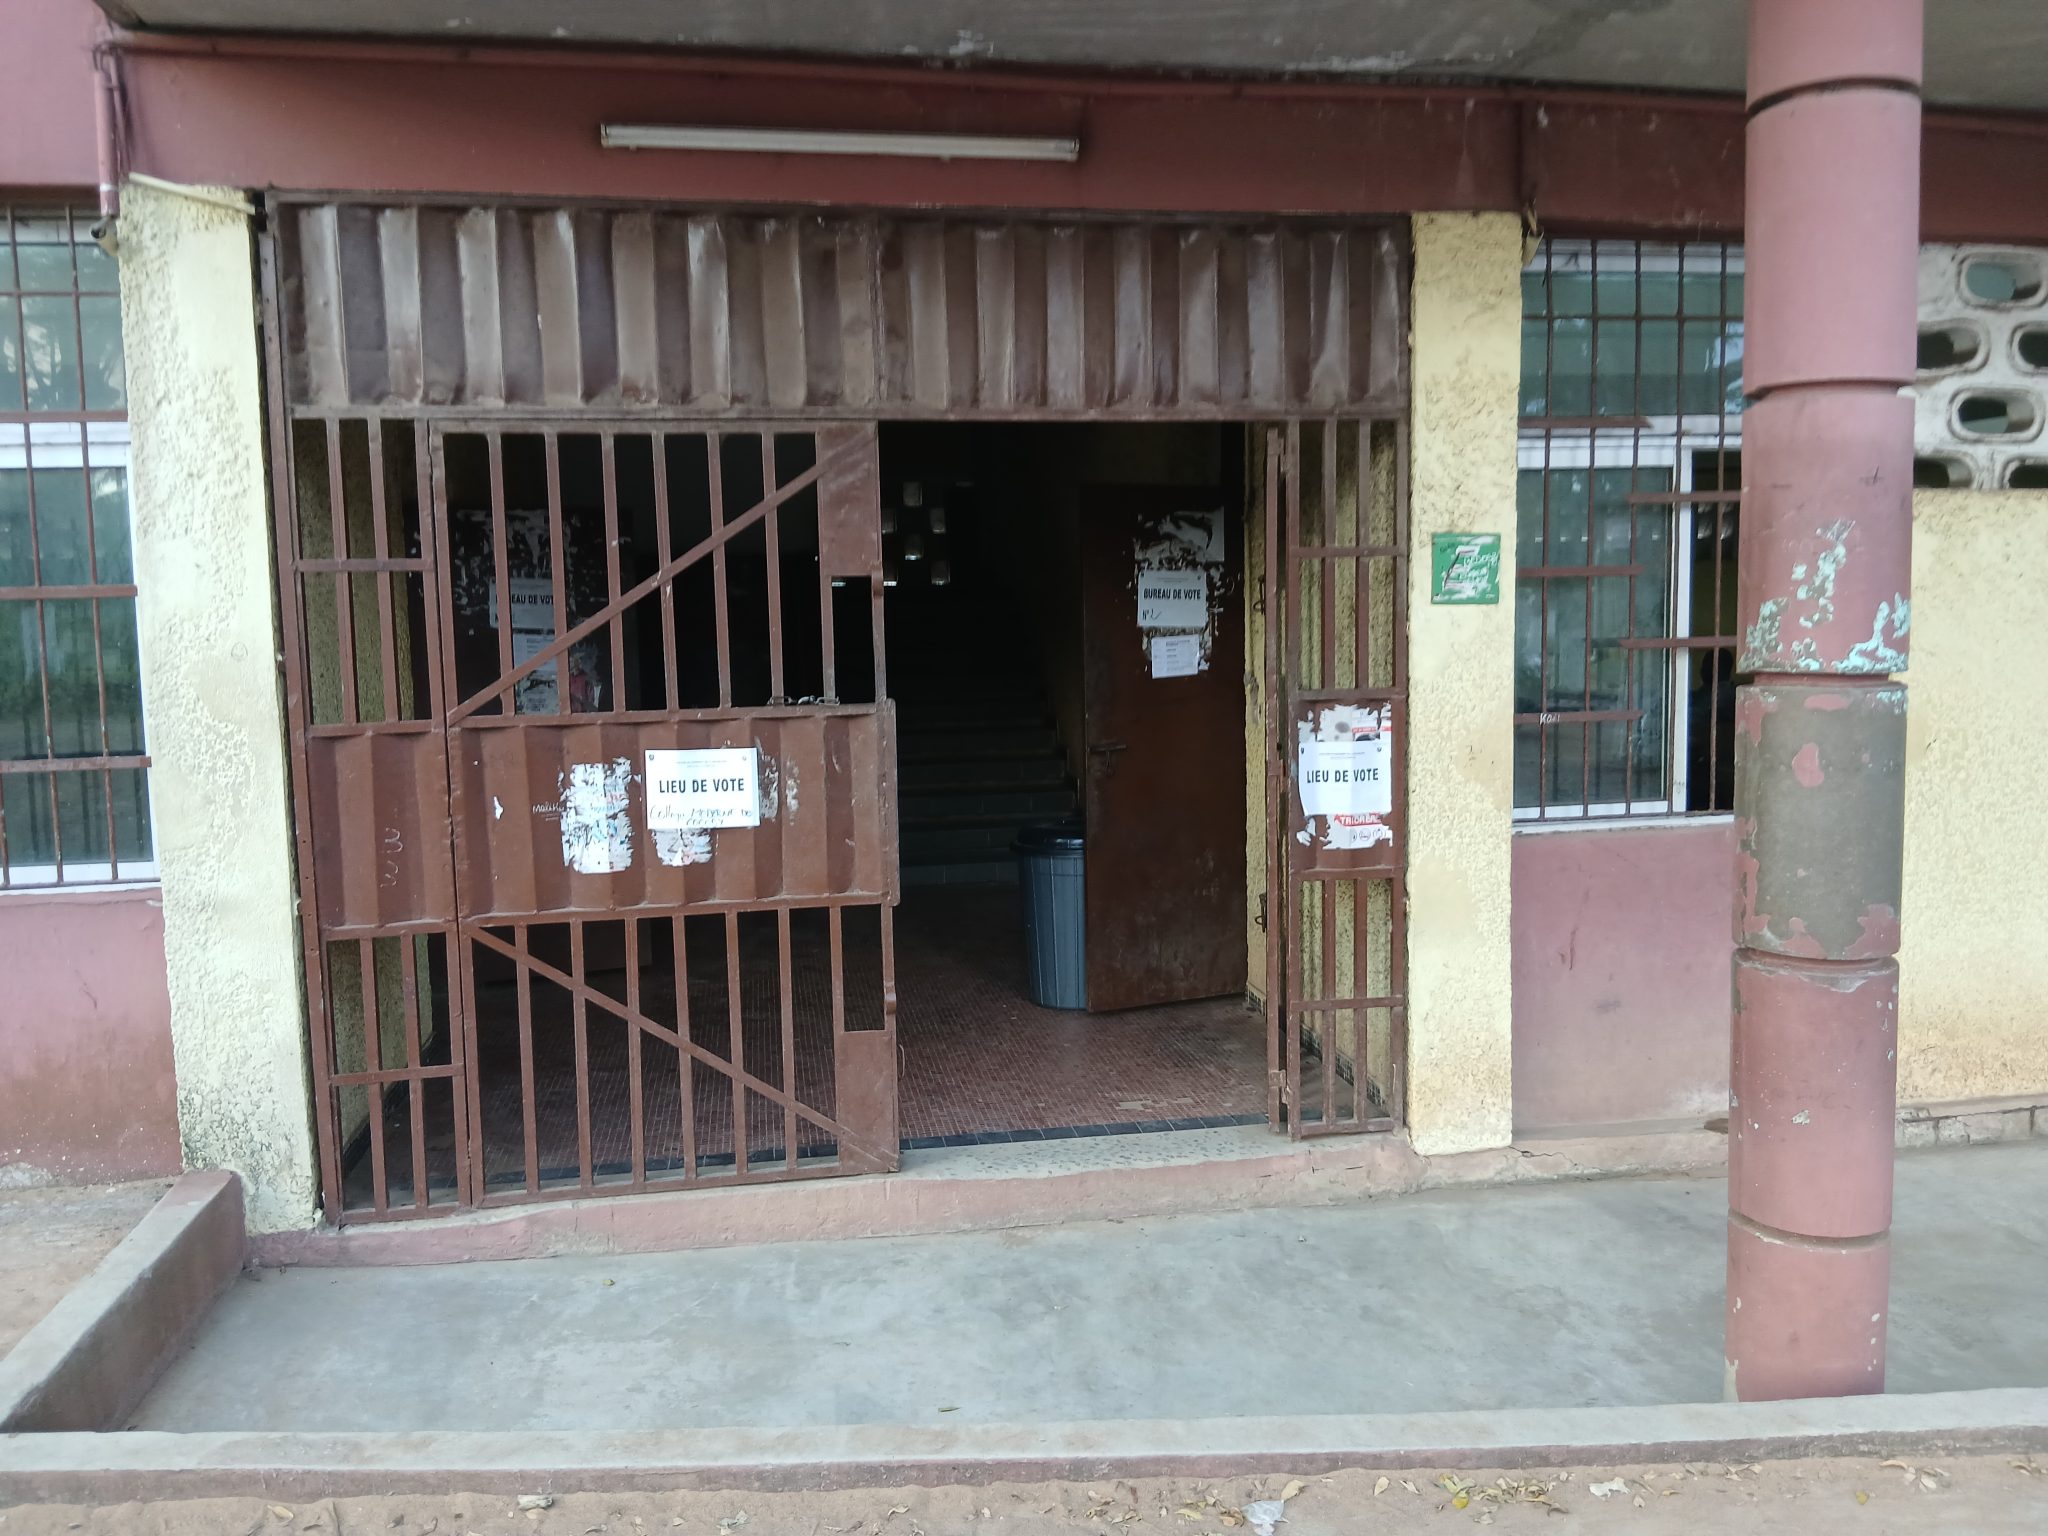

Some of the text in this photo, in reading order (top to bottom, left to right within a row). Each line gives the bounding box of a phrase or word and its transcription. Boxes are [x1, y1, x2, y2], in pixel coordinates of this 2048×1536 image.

[528, 594, 537, 604] DE
[540, 594, 554, 605] VOT
[1143, 588, 1201, 600] BUREAU DE VOTE
[1307, 768, 1379, 783] LIEU DE VOTE
[659, 778, 745, 793] LIEU DE VOTE
